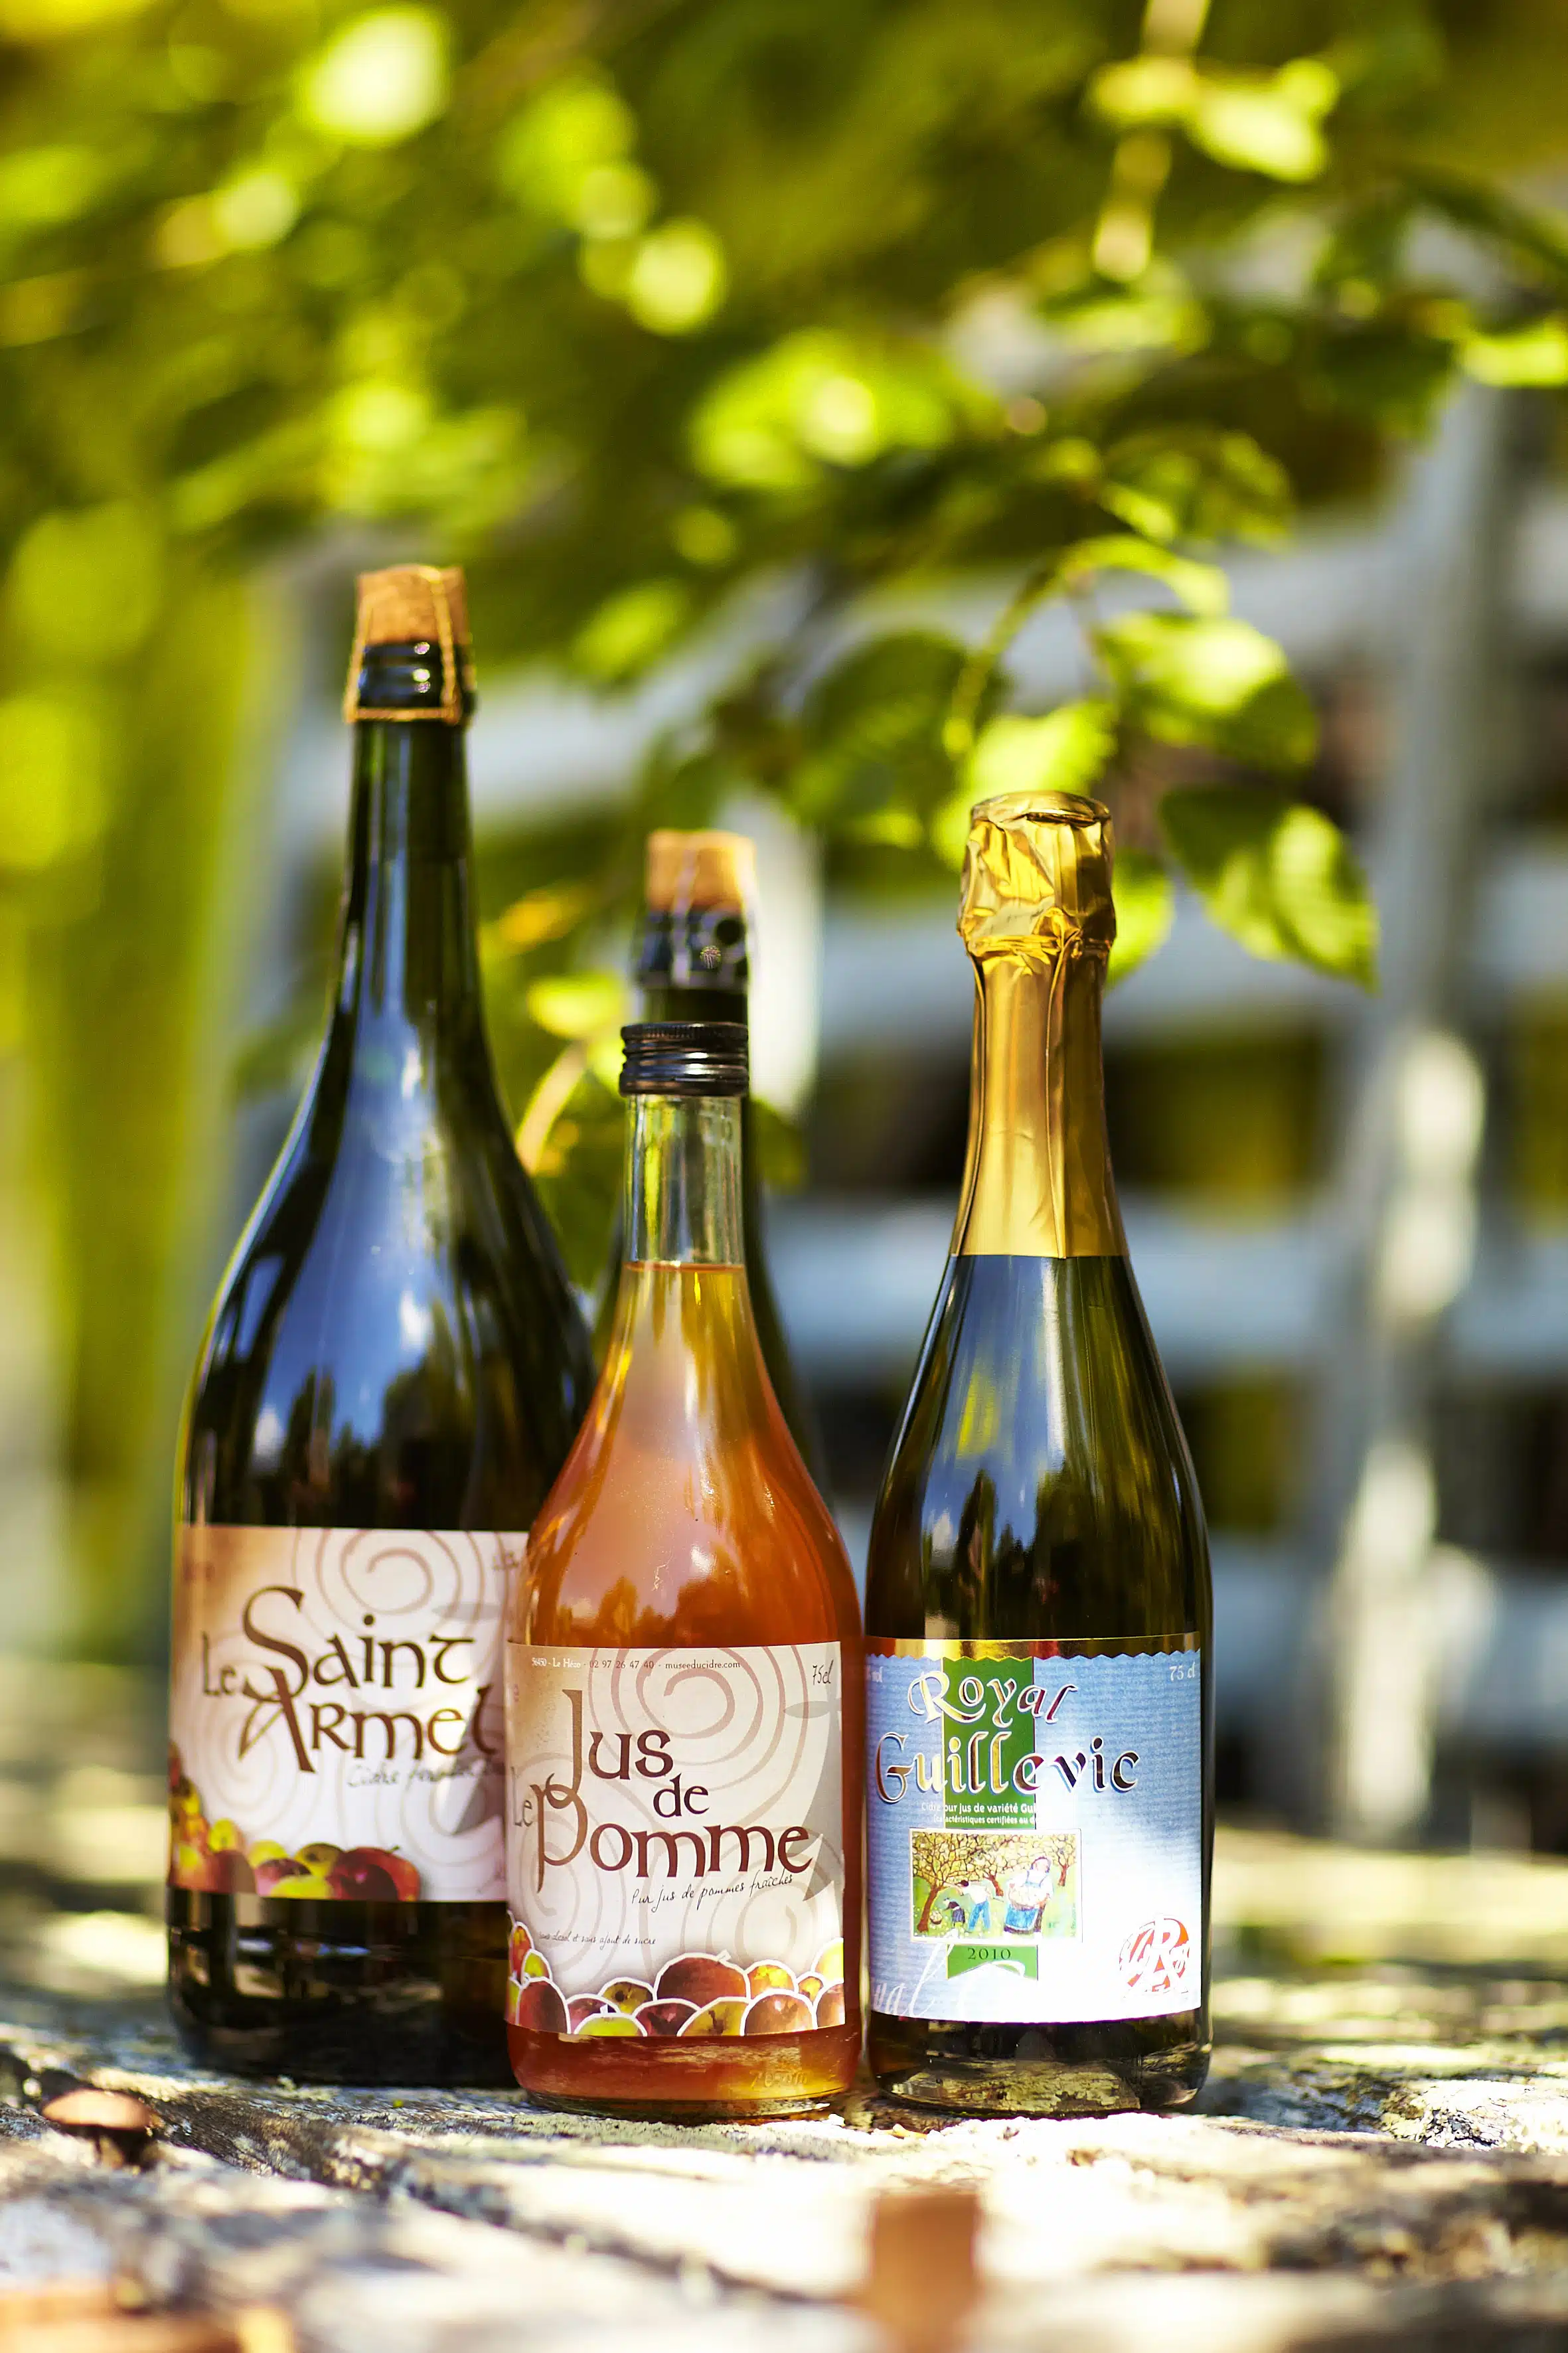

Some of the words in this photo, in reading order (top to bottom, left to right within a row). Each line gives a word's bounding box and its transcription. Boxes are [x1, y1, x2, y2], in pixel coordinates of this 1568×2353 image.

[202, 1631, 236, 1696] Le
[242, 1585, 475, 1702] Saint
[589, 1660, 598, 1668] 02
[665, 1659, 741, 1669] museeducidre.com
[1169, 1664, 1184, 1682] 75
[238, 1666, 497, 1773] Armel
[907, 1670, 1079, 1729] Royal
[546, 1689, 674, 1811] Jus
[874, 1730, 1140, 1804] Guillevic
[510, 1766, 534, 1826] Le
[653, 1773, 709, 1817] de
[959, 1803, 972, 1815] jus
[973, 1803, 985, 1813] de
[987, 1802, 1019, 1813] variété
[986, 1815, 1018, 1825] certifiées
[631, 1888, 655, 1904] Pur
[651, 1884, 675, 1913] jus
[682, 1884, 694, 1900] de
[696, 1882, 745, 1911] pommes
[749, 1868, 793, 1898] fraîches
[599, 1931, 621, 1950] ajout
[622, 1934, 631, 1944] de
[967, 1947, 1012, 1961] 2010
